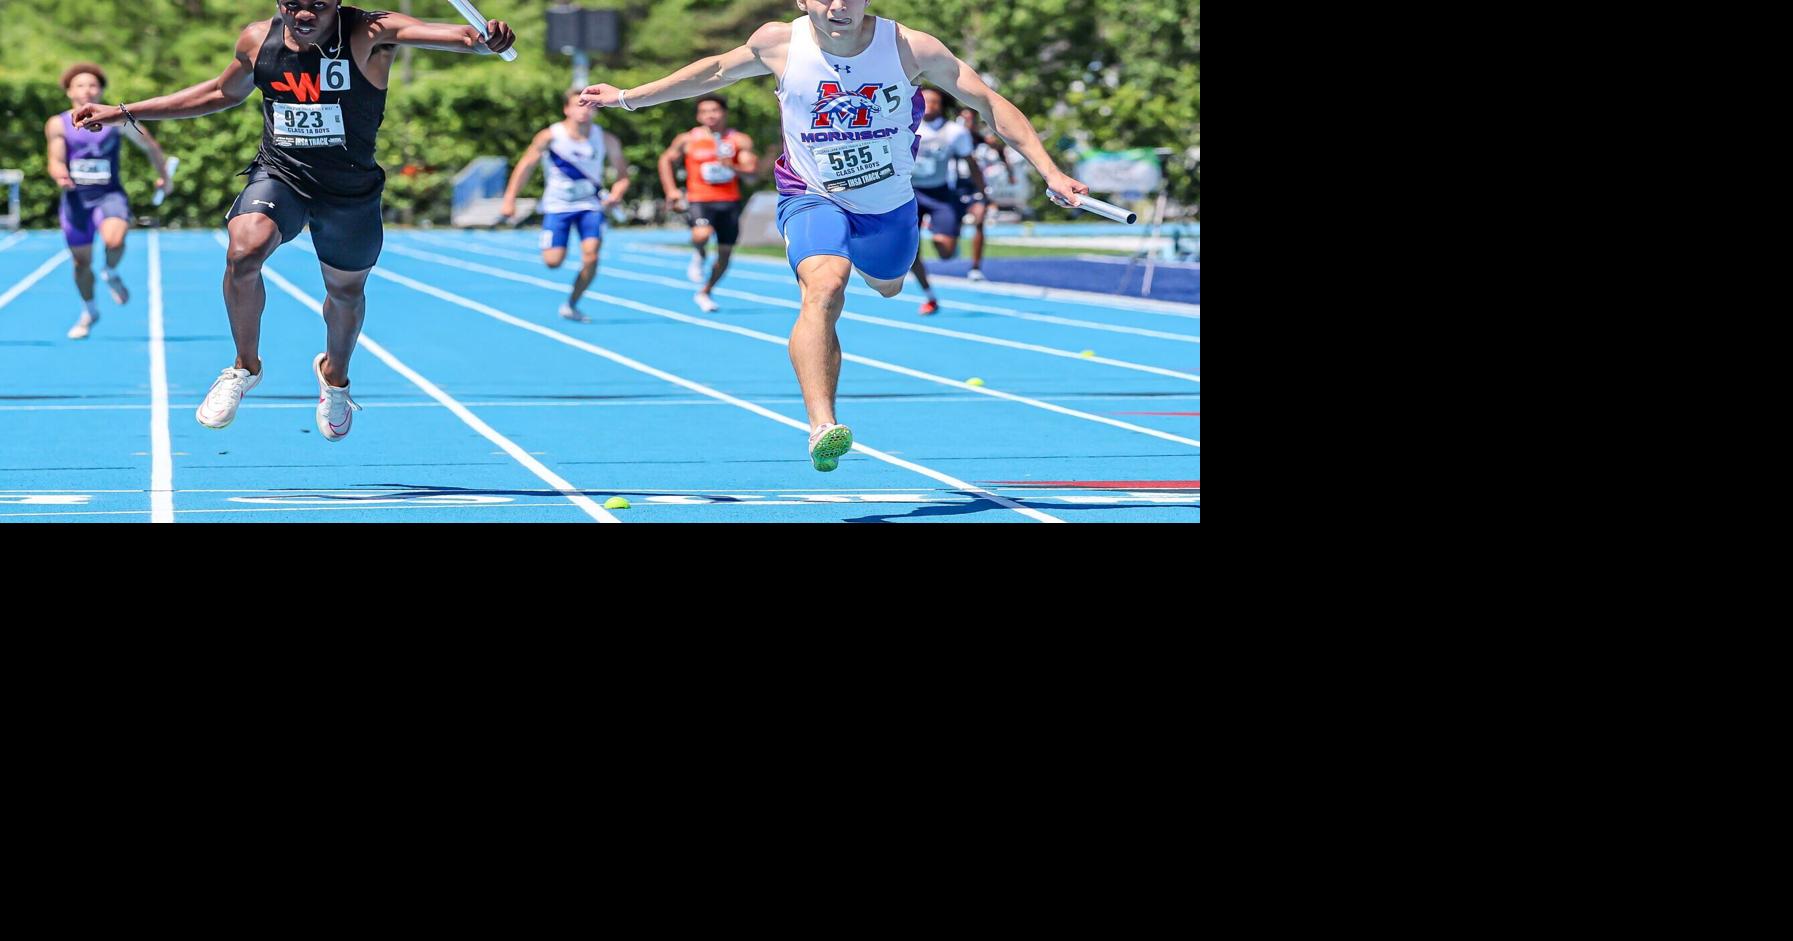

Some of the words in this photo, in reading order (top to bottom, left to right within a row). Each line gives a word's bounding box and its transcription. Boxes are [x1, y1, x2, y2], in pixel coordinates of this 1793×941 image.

[326, 61, 344, 89] 6
[882, 85, 901, 113] 5
[284, 110, 324, 128] 923
[309, 137, 328, 146] TRACK
[800, 127, 899, 143] MORRISON
[828, 145, 873, 171] 555
[836, 167, 856, 177] CLASS
[856, 165, 864, 173] 1A
[864, 161, 880, 171] BOYS
[847, 177, 862, 188] IHSA
[862, 172, 881, 184] TRACK
